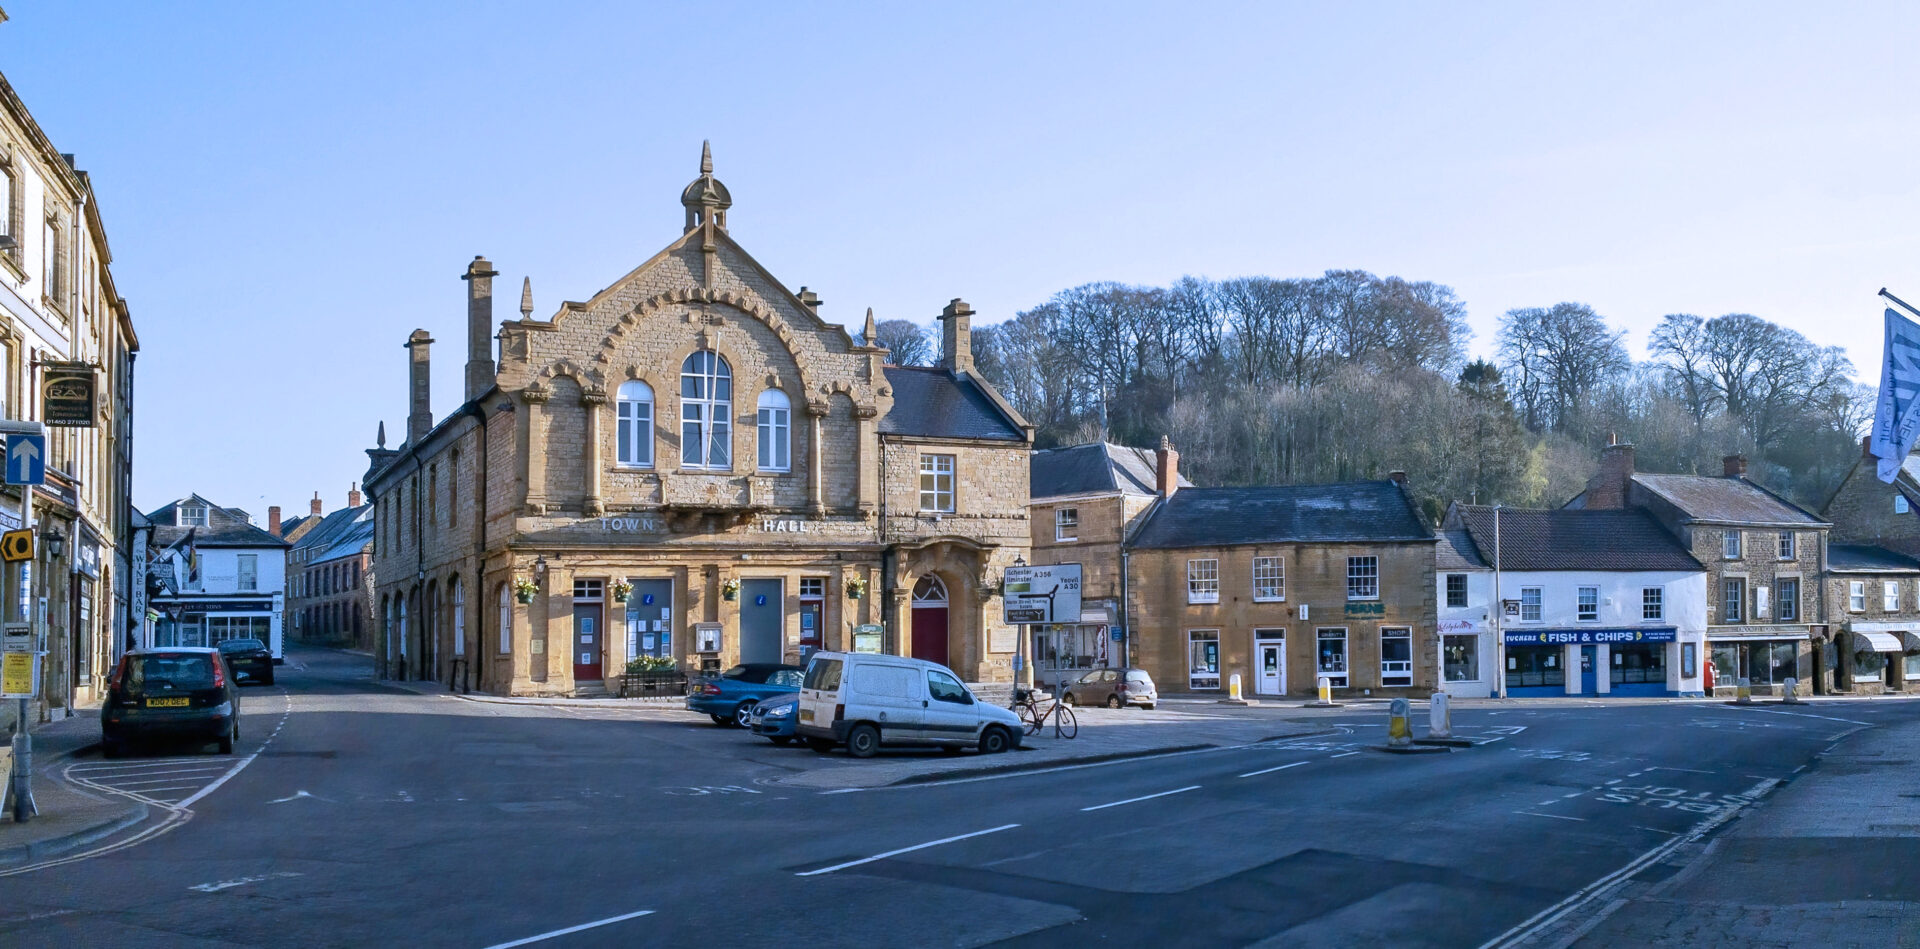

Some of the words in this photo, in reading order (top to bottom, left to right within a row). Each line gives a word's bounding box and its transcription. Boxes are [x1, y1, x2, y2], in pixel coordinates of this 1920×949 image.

[600, 518, 653, 530] TOWN
[763, 519, 808, 532] HALL
[1506, 634, 1537, 642] TUCKERS
[1549, 633, 1577, 642] FISH
[1581, 633, 1591, 642] &
[1595, 632, 1634, 641] CHIPS
